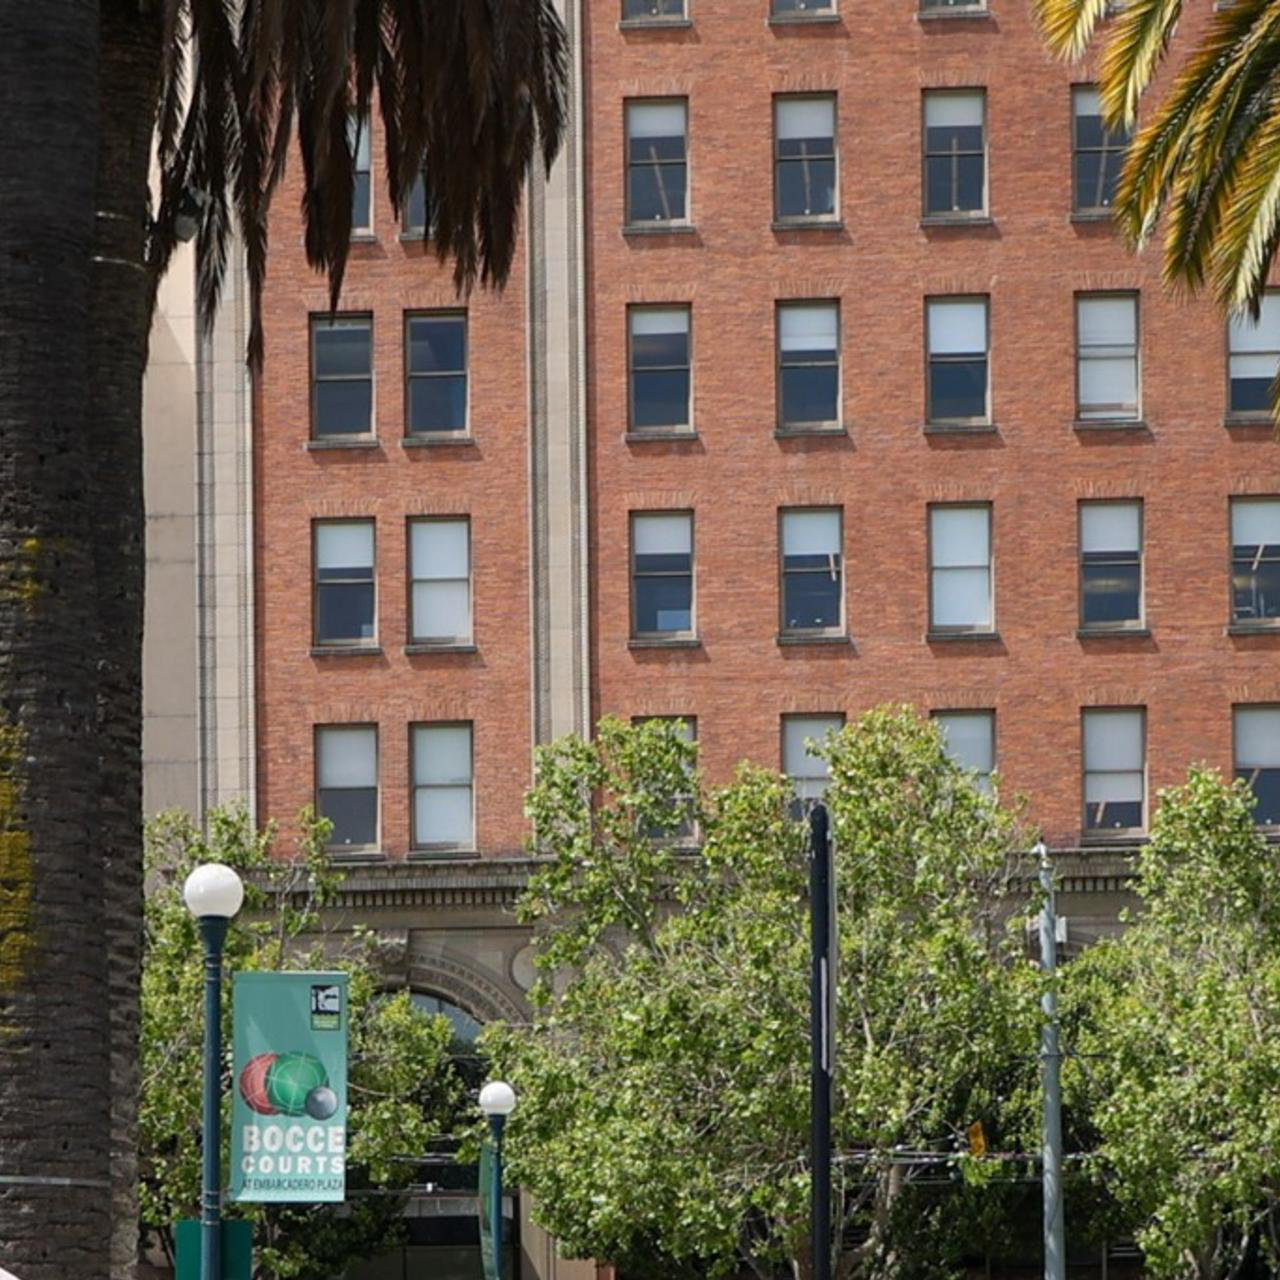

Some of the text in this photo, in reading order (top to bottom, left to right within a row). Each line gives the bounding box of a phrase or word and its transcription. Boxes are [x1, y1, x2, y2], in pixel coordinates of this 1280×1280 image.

[242, 1124, 345, 1153] BOCCE
[241, 1155, 345, 1174] COURTS
[253, 1178, 316, 1191] EMBARCADERO
[317, 1179, 343, 1191] PLAZA
